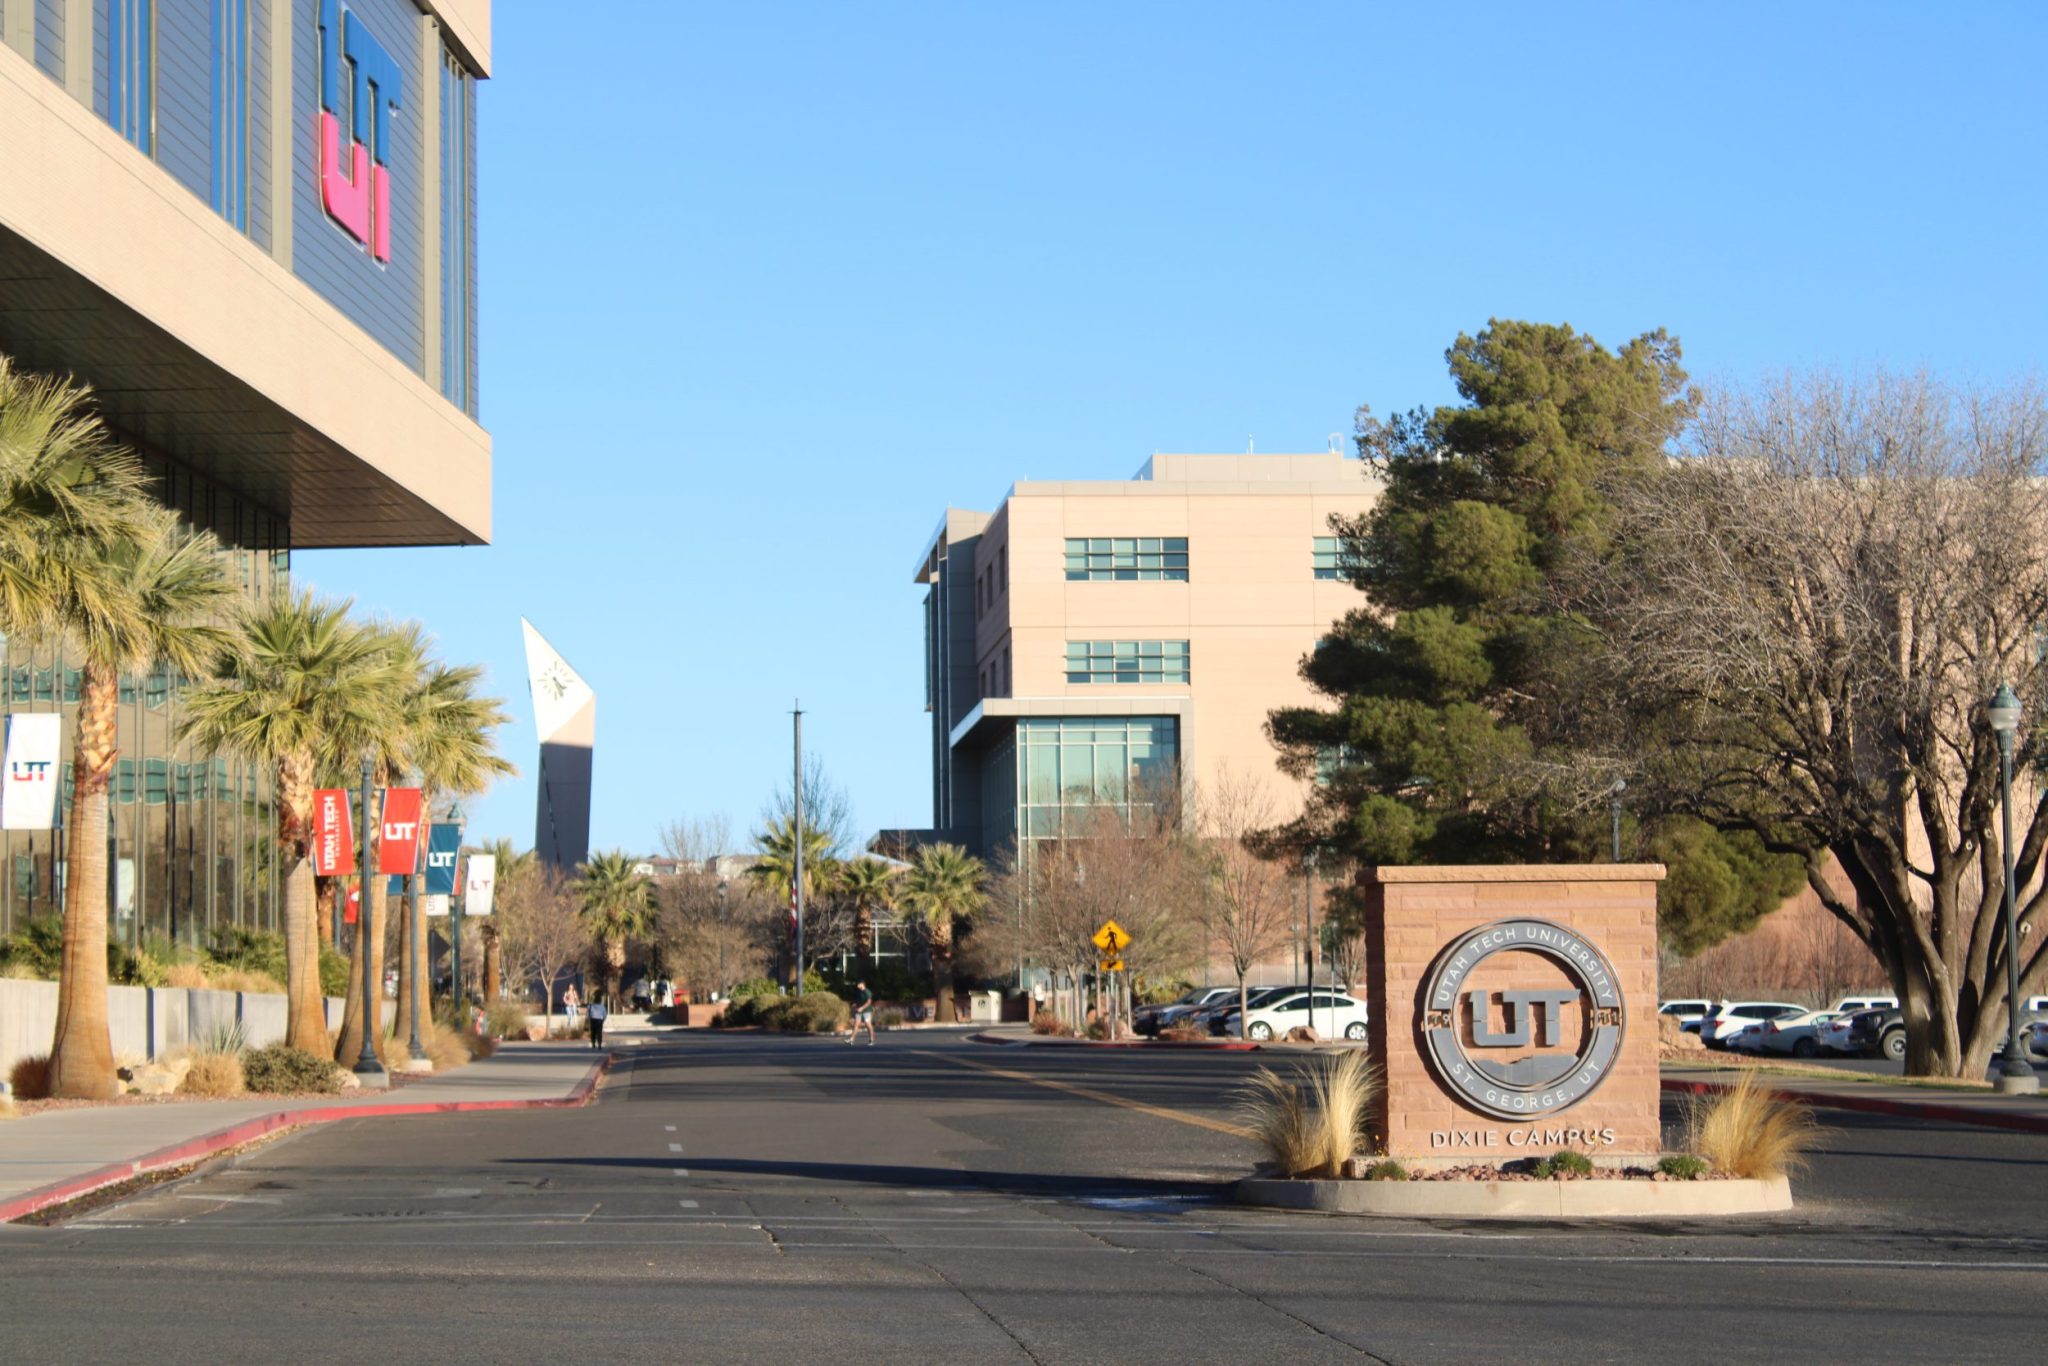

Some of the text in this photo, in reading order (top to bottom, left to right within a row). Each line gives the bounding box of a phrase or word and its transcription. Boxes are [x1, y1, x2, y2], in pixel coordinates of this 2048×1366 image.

[12, 762, 51, 781] UT
[324, 795, 335, 870] UTAH TECH
[384, 822, 416, 840] UT
[428, 852, 455, 867] UT
[1439, 927, 1613, 1001] UTAH TECH UNIVERSITY
[1469, 990, 1581, 1046] UT
[1452, 1060, 1600, 1109] ST. GEORGE, UT
[1431, 1128, 1616, 1148] DIXIE CAMPUS
